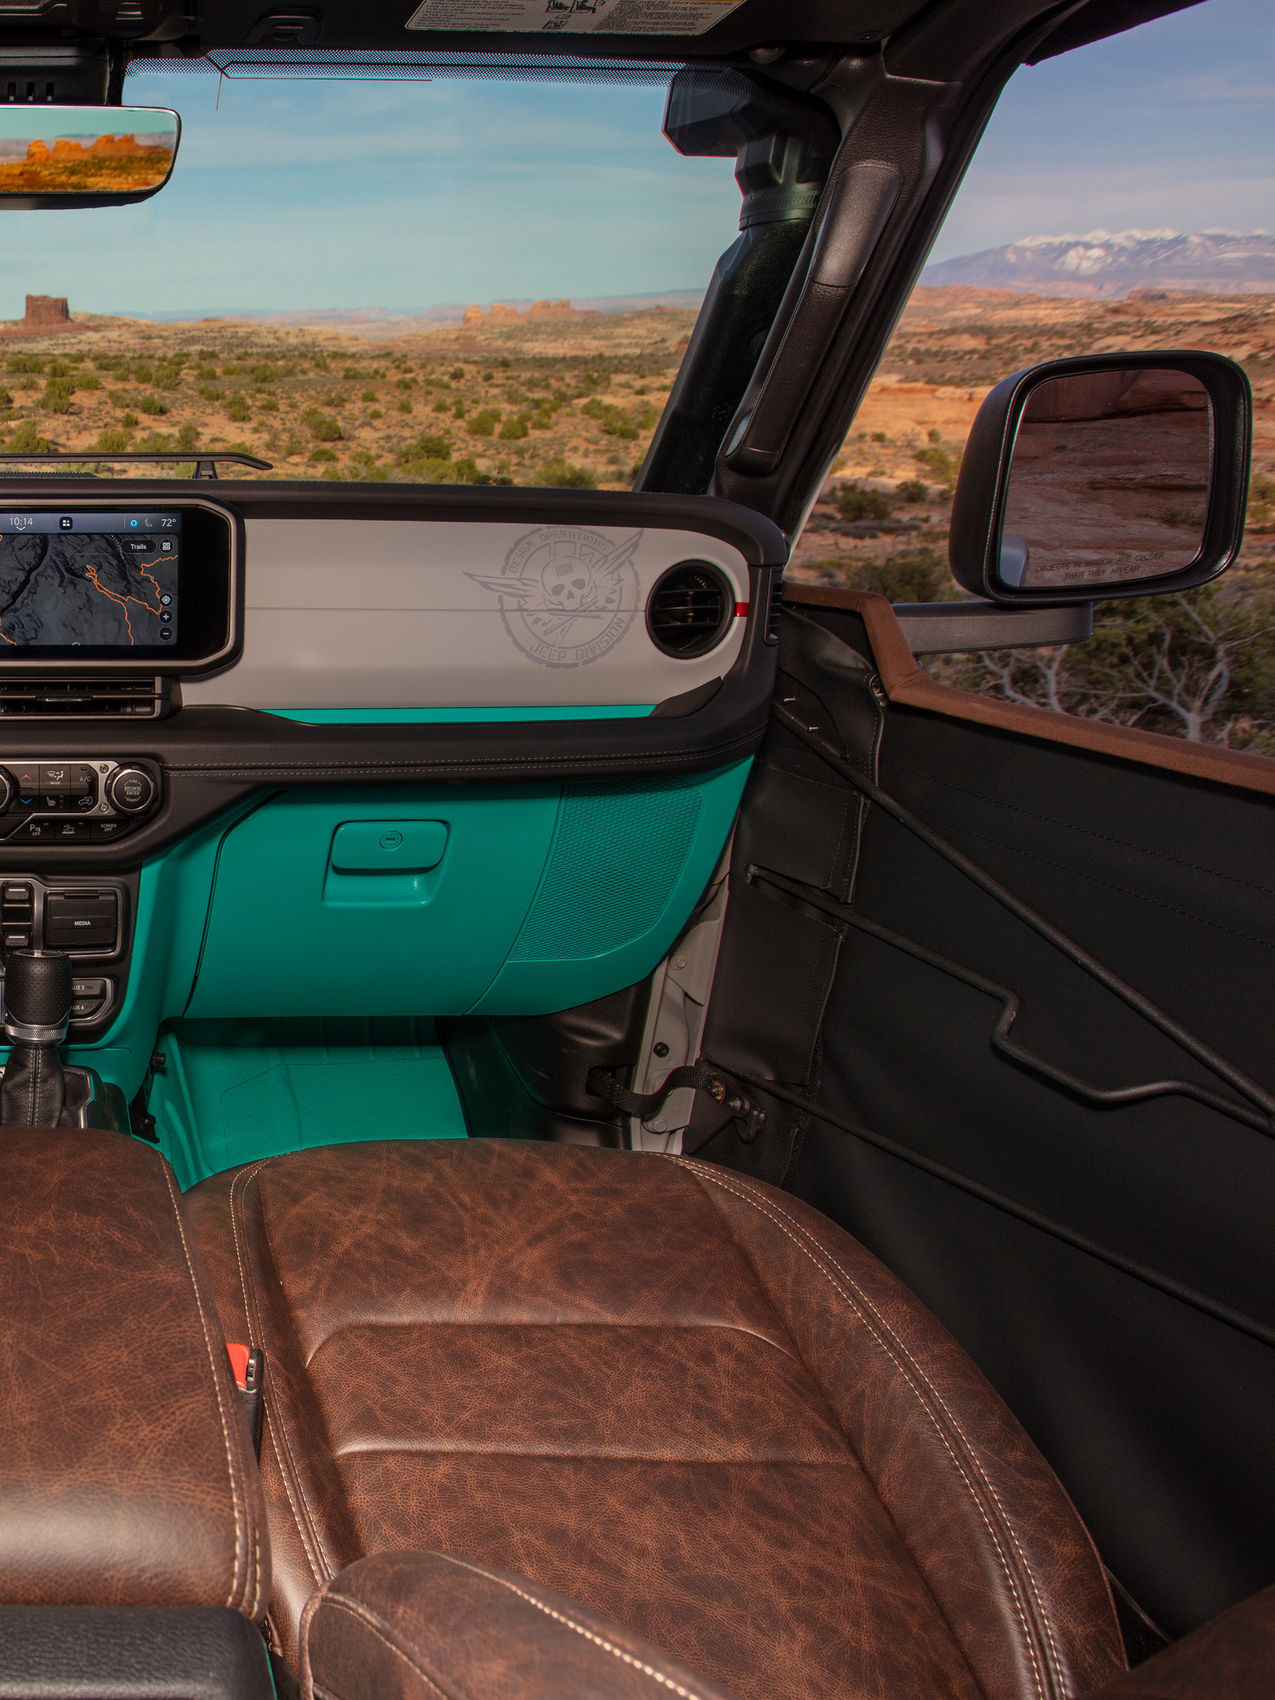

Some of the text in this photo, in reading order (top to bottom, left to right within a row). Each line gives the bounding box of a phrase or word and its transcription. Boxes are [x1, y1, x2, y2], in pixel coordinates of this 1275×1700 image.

[9, 517, 33, 526] 10:14
[538, 529, 609, 551] OPERATIONS
[509, 539, 535, 574] DESIGN
[1035, 562, 1070, 572] OBJECTS
[1086, 558, 1114, 567] MIRROR
[1117, 556, 1132, 564] ARE
[1135, 552, 1165, 562] CLOSER
[1065, 566, 1140, 579] THAN THEY APPEAR
[575, 616, 626, 661] DIVISION
[529, 642, 567, 662] JEEP
